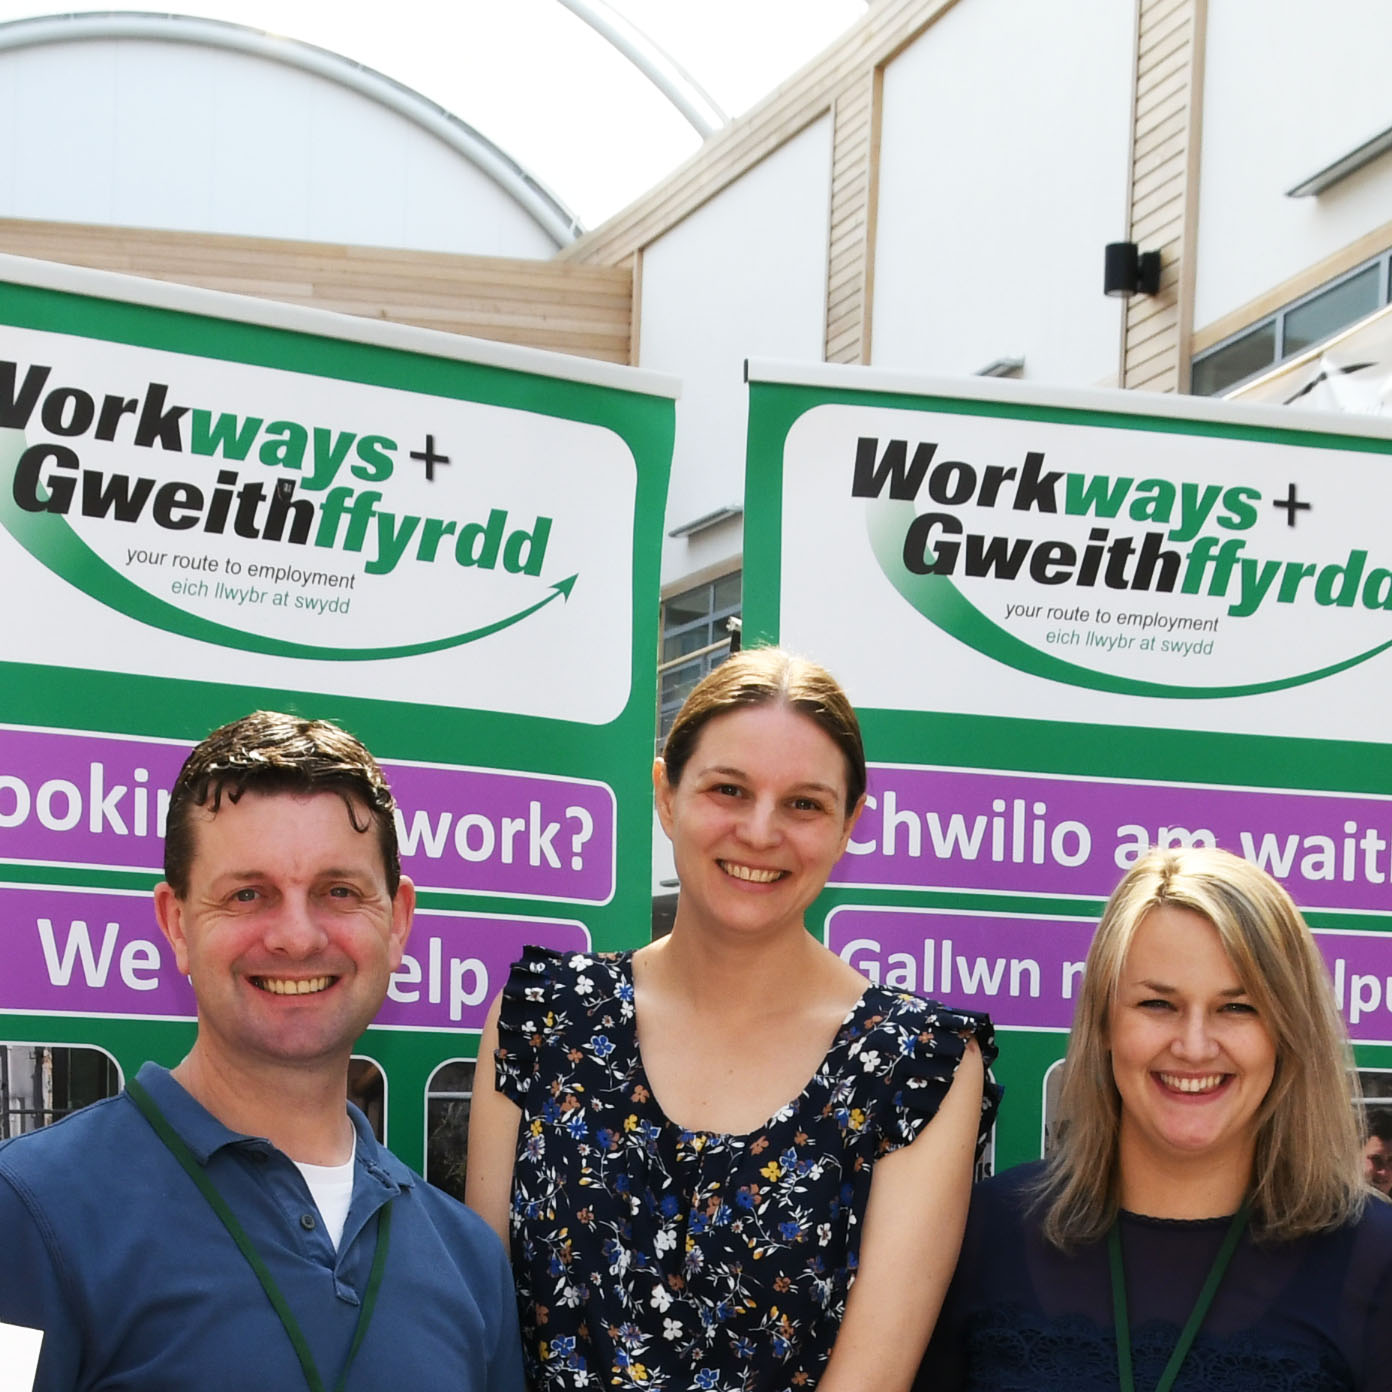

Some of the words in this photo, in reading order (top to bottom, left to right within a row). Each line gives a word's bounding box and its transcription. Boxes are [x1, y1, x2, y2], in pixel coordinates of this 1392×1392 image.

[12, 443, 553, 576] Gweithffyrdd
[125, 548, 168, 566] your
[172, 552, 219, 572] route
[224, 556, 242, 575] to
[247, 559, 356, 590] employment
[171, 578, 209, 598] eich
[215, 582, 267, 606] llwybr
[272, 590, 289, 606] at
[294, 595, 351, 615] swydd
[1005, 603, 1043, 619] your
[1047, 606, 1090, 622] route
[1095, 608, 1112, 623] to
[1117, 611, 1219, 633] employment
[1046, 628, 1081, 644] eich
[1086, 631, 1135, 652] llwybr
[1140, 635, 1156, 650] at
[1160, 639, 1215, 658] swydd
[395, 798, 596, 873] work?
[845, 792, 1092, 868] Chwilio
[36, 917, 162, 992] We
[393, 936, 489, 1022] elp
[841, 939, 1040, 1000] Gallwn
